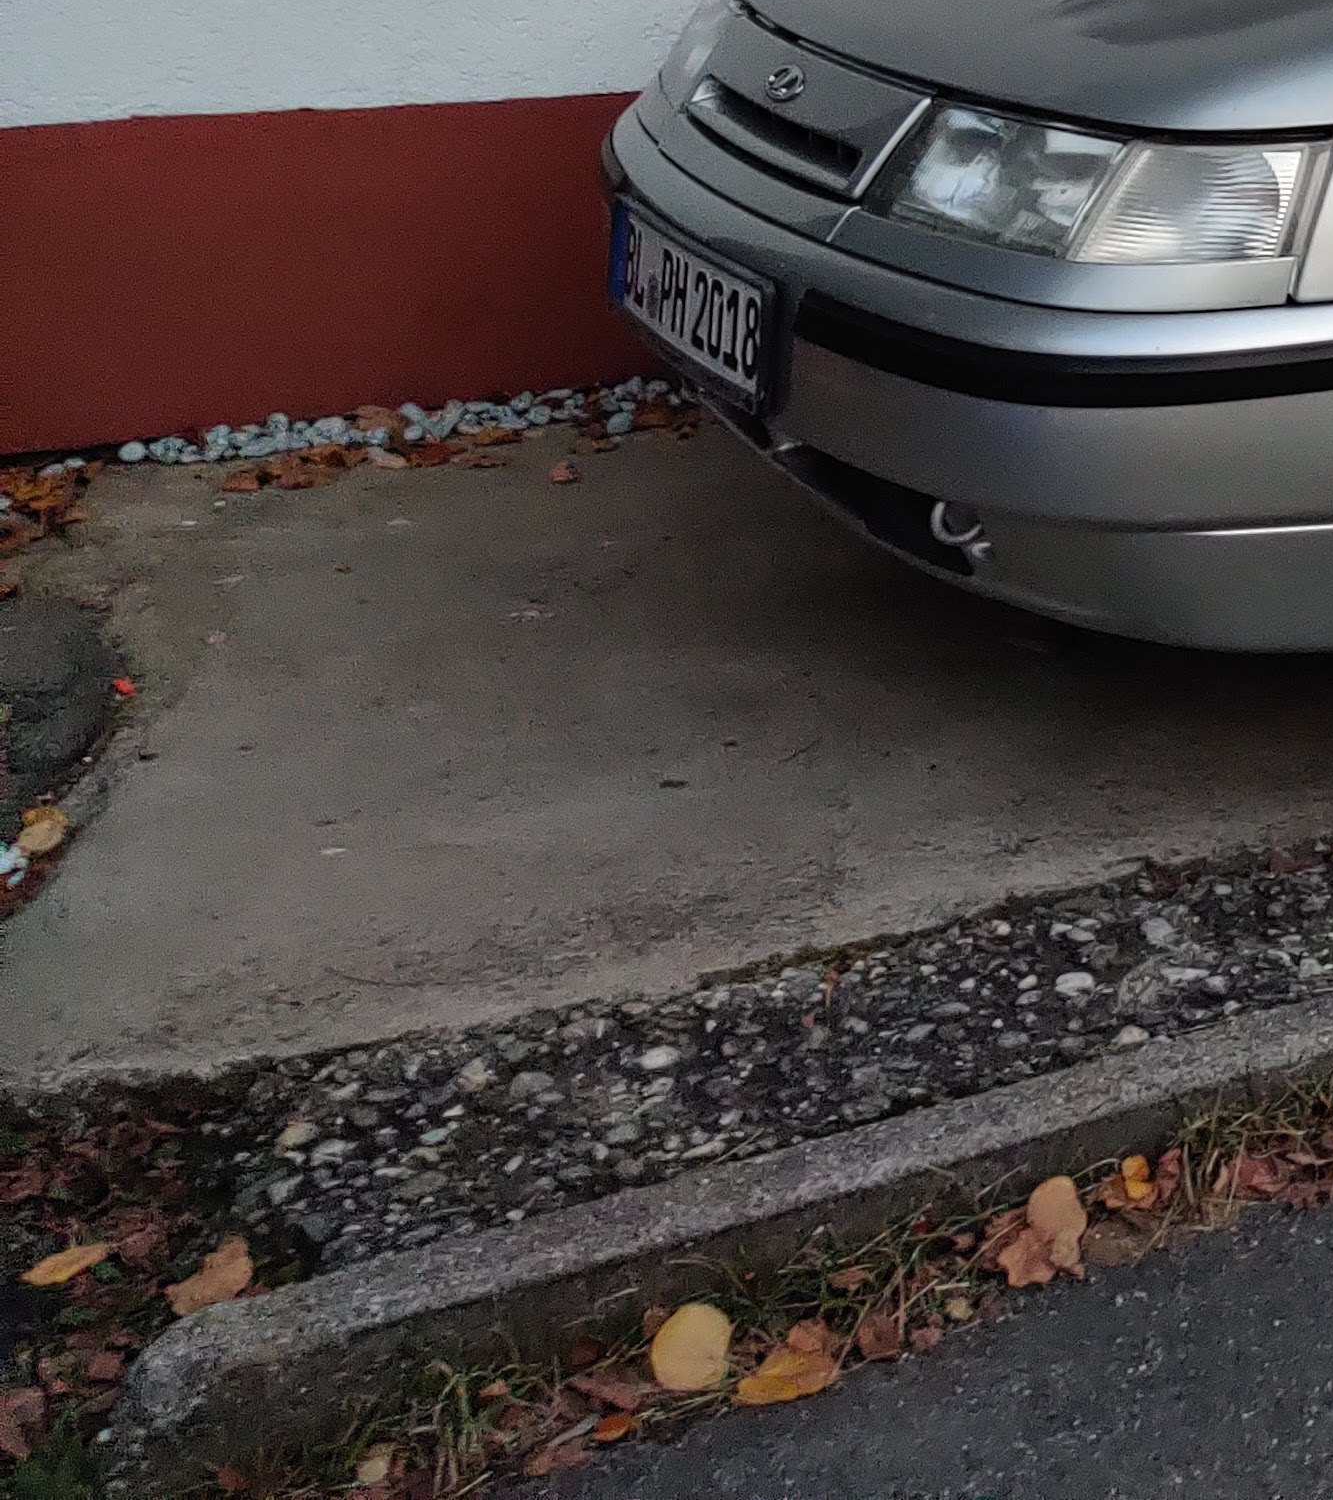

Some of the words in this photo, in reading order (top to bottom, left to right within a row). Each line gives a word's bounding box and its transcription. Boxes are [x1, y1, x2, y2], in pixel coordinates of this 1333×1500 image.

[625, 221, 644, 308] BL
[658, 249, 689, 338] PH
[691, 270, 759, 380] 2018
